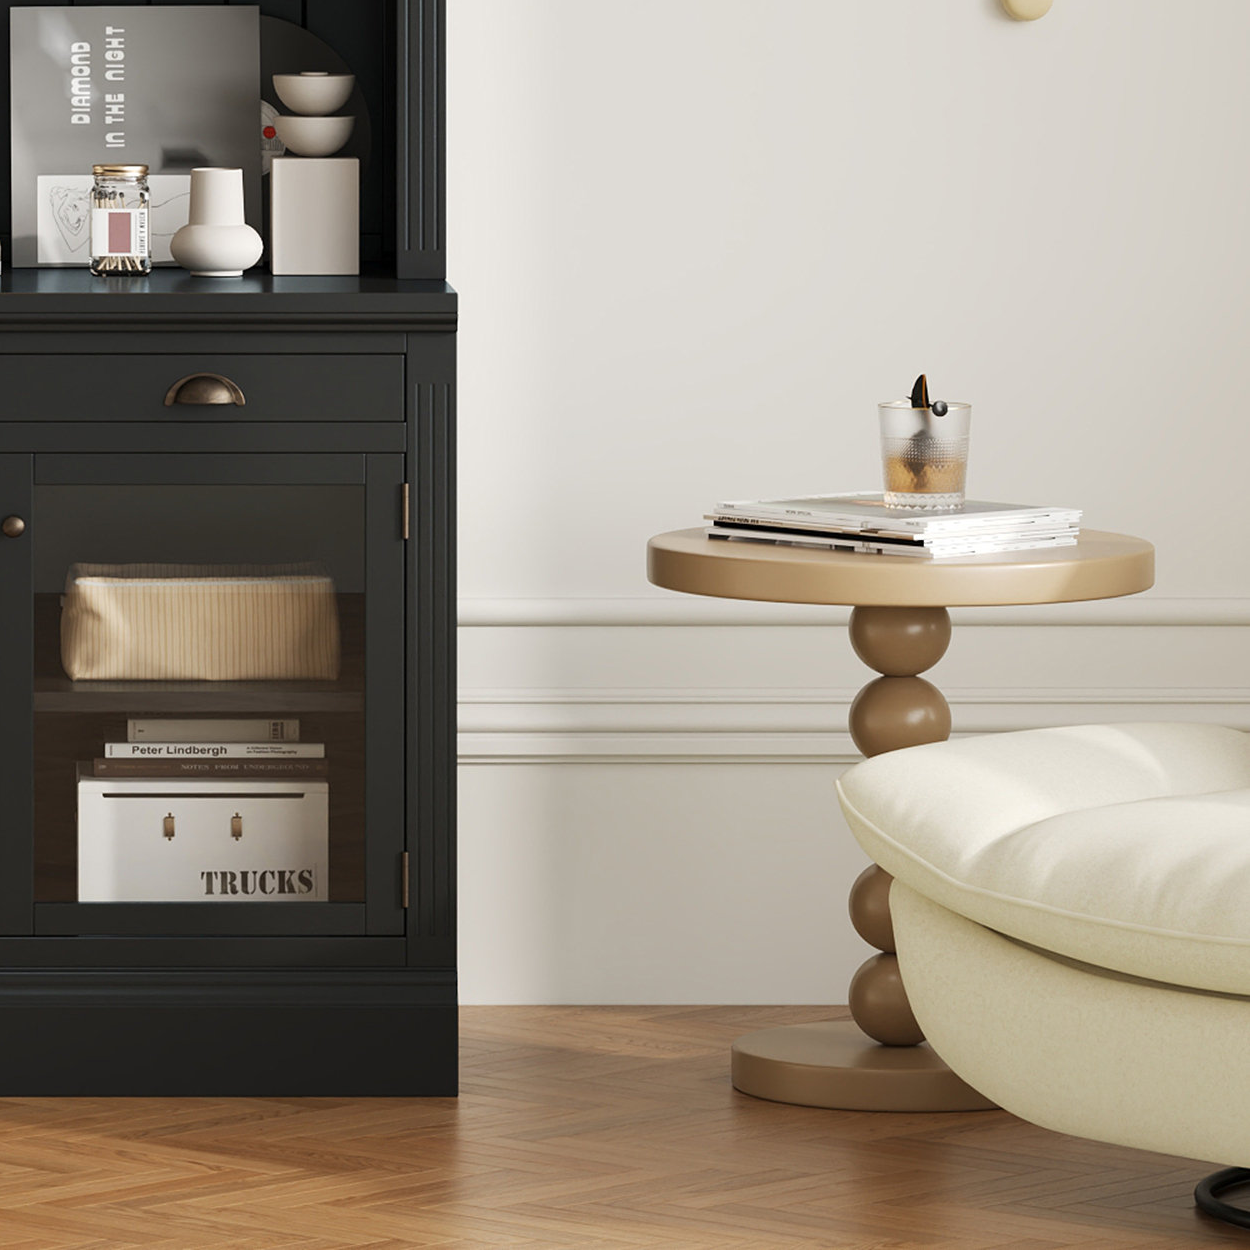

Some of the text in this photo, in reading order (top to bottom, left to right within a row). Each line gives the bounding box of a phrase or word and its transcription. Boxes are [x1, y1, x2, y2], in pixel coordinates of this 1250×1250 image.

[71, 42, 91, 124] DIAMOND
[105, 26, 125, 147] IN THE NIGHT
[132, 745, 227, 756] Peter Lindbergh
[200, 870, 313, 895] TRUCKS
